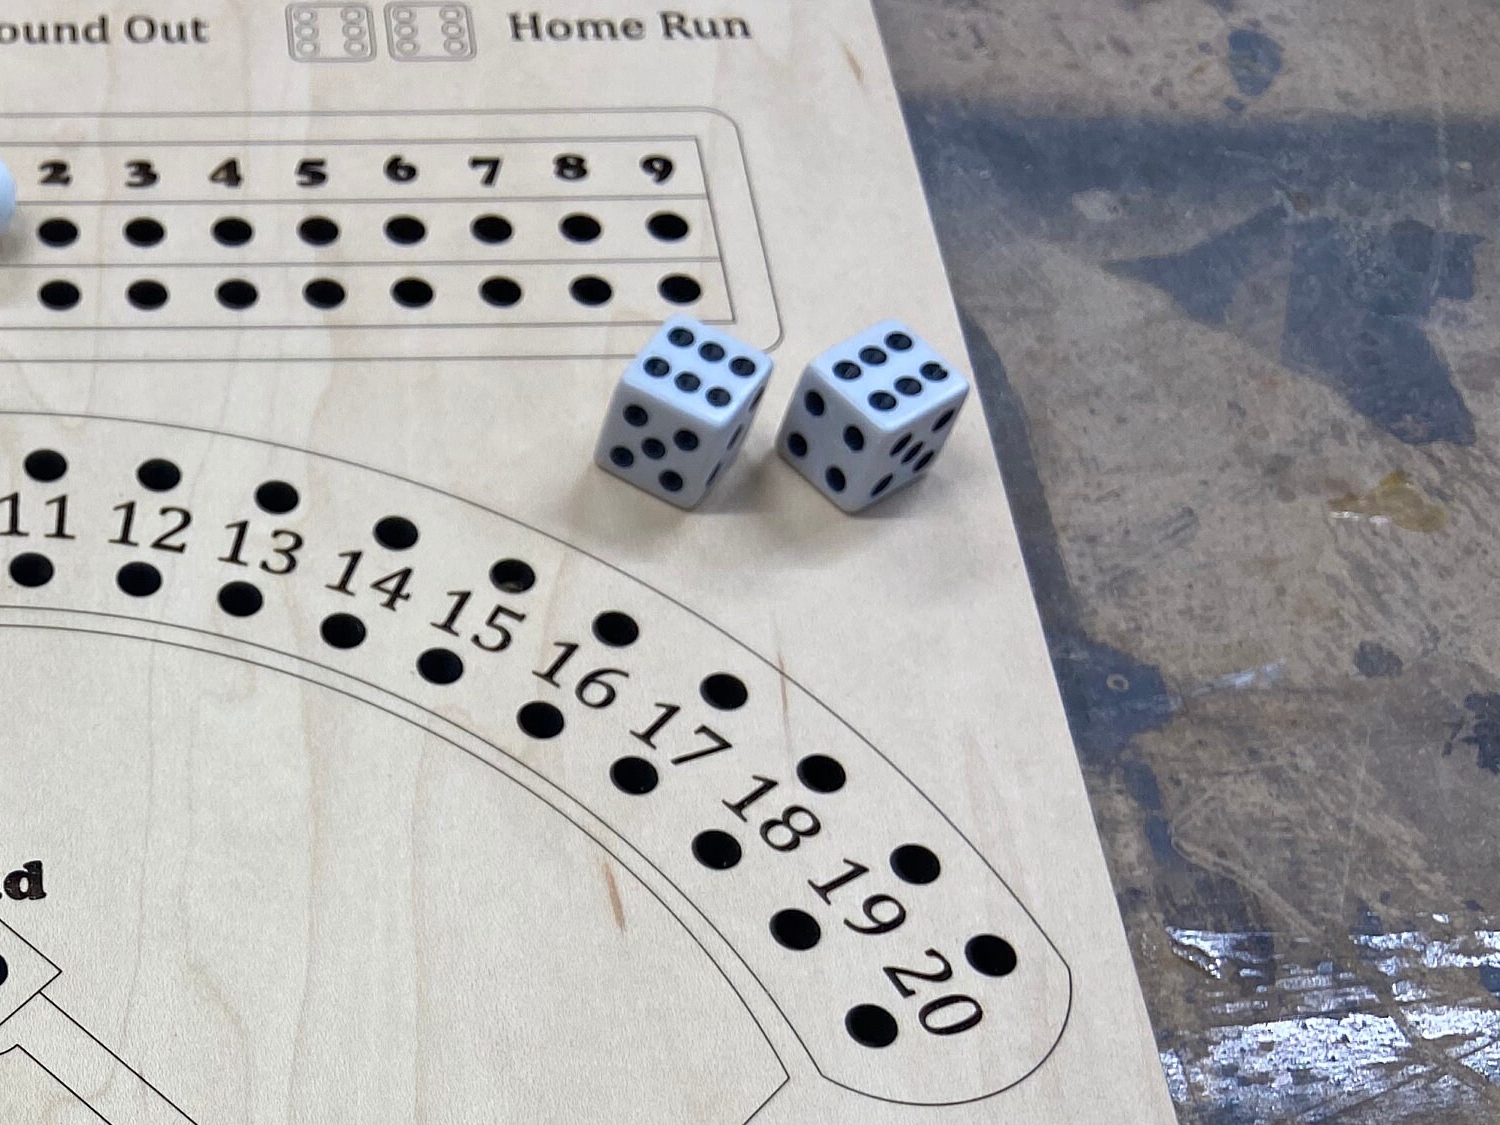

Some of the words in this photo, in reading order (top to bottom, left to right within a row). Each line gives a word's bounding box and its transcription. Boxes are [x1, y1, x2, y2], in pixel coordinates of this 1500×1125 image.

[124, 15, 207, 44] Out
[508, 12, 644, 42] Home
[659, 10, 752, 40] Run
[39, 159, 72, 187] 2
[126, 159, 159, 189] 3
[209, 157, 243, 188] 4
[296, 158, 328, 188] 5
[383, 155, 418, 183] 6
[468, 156, 502, 187] 7
[554, 153, 589, 182] 8
[640, 154, 675, 184] 9
[108, 500, 193, 554] 12
[217, 520, 304, 576] 13
[325, 550, 413, 612] 14
[430, 590, 527, 653] 15
[531, 641, 630, 710] 16
[629, 702, 733, 766] 17
[721, 775, 822, 853] 18
[807, 858, 907, 936] 19
[882, 948, 984, 1036] 20
